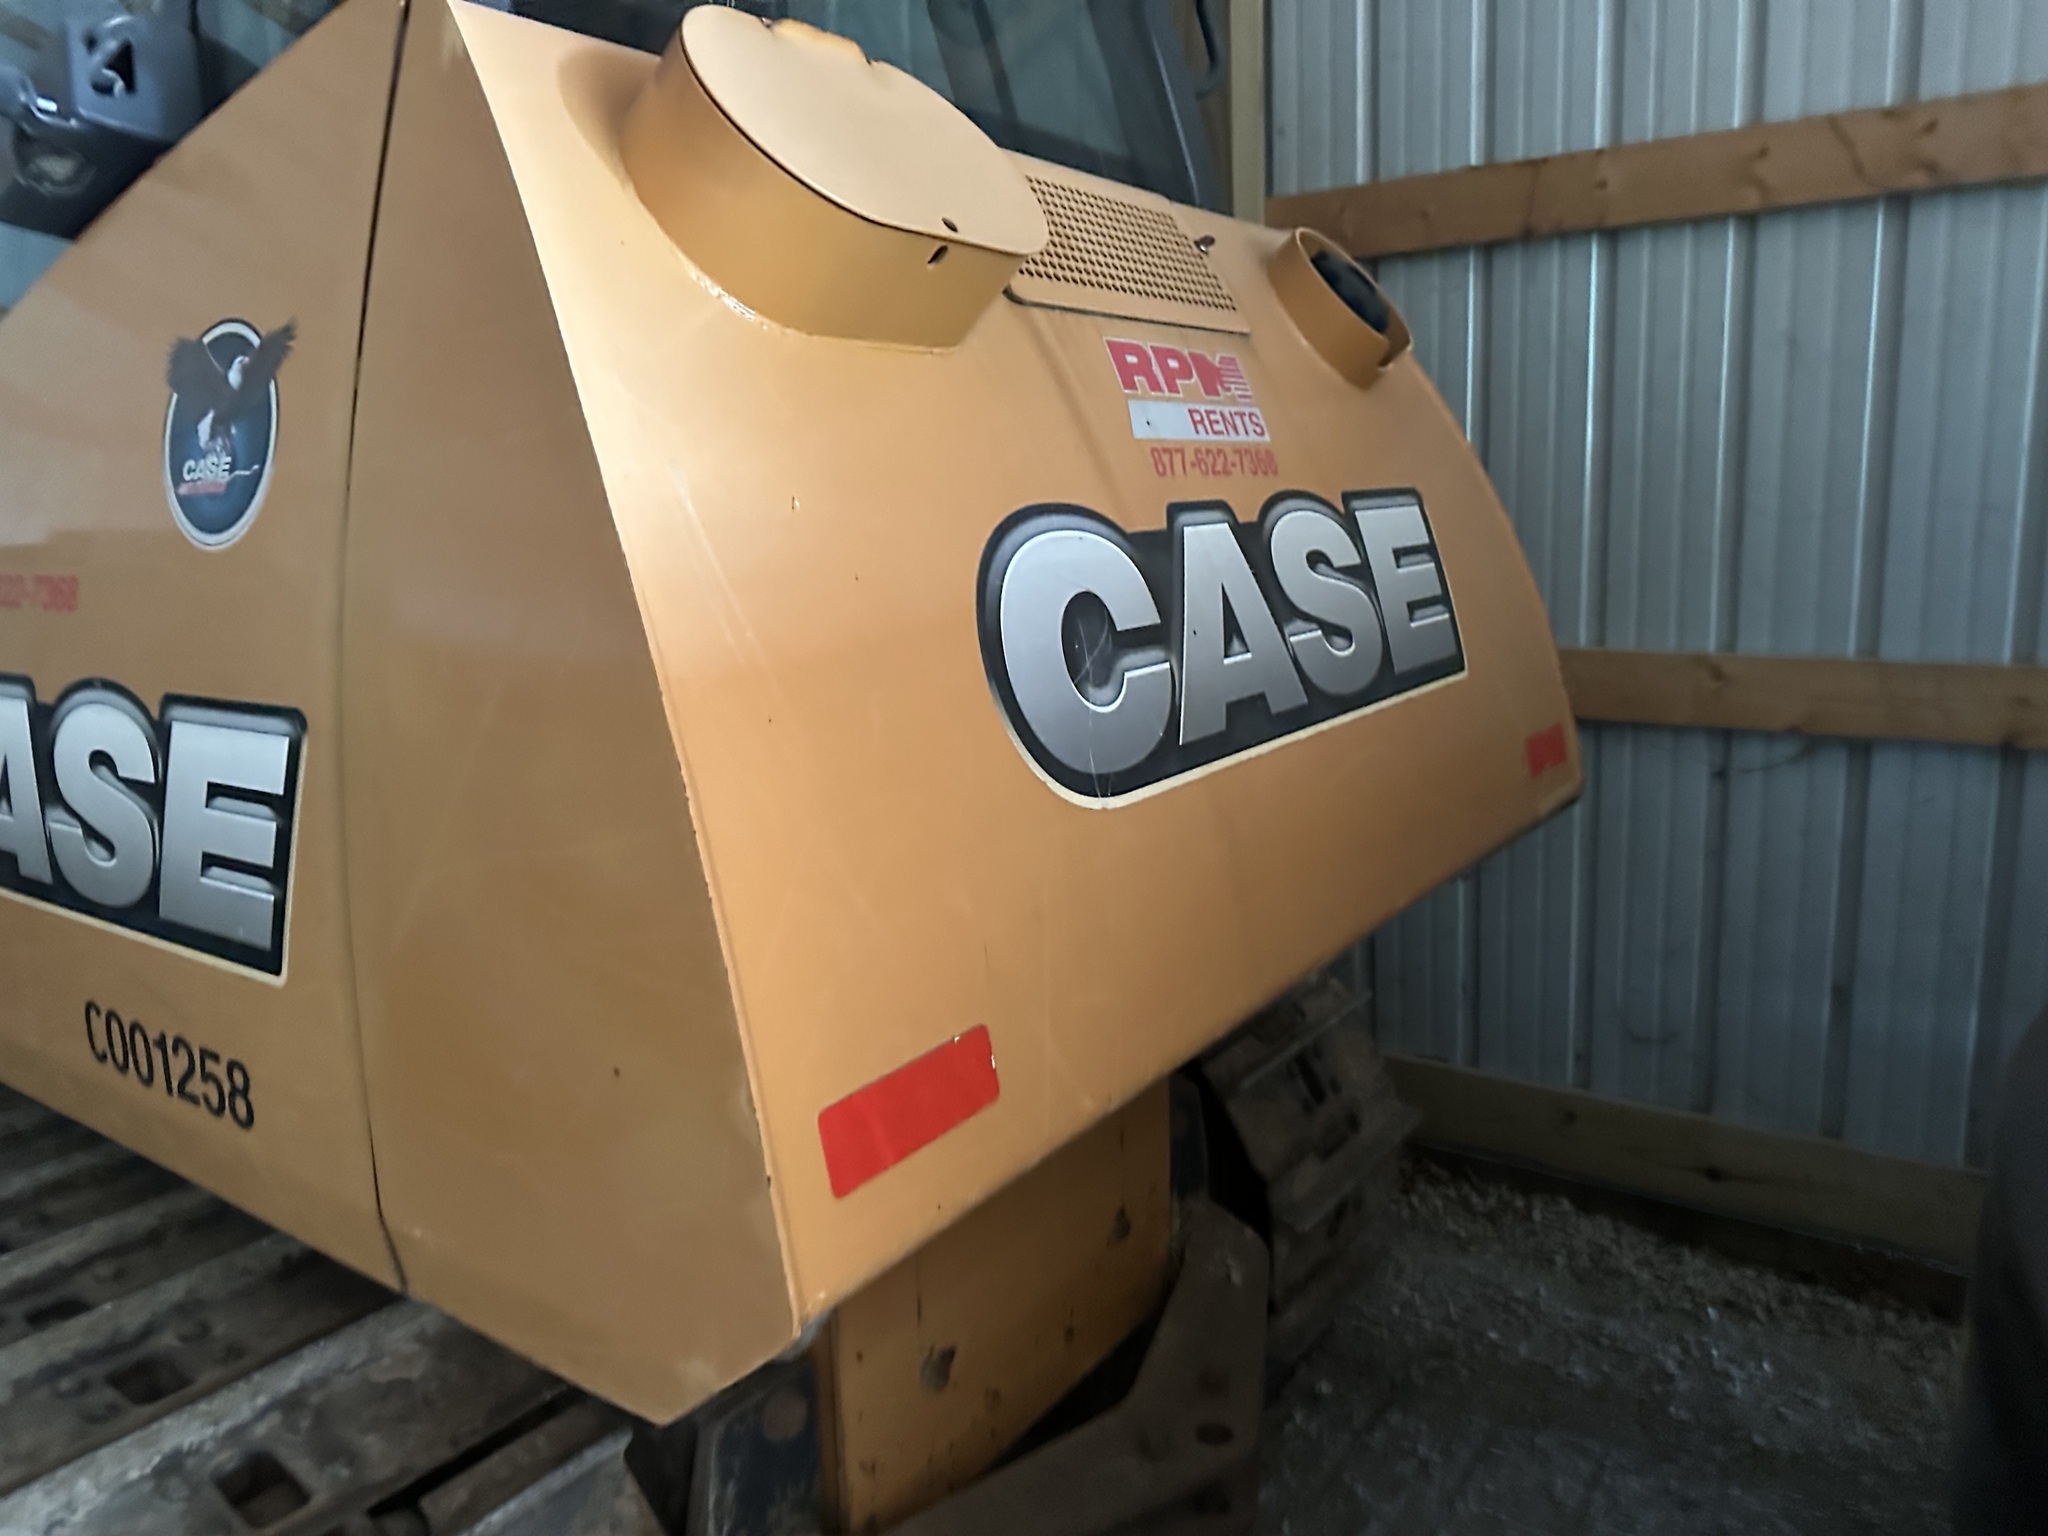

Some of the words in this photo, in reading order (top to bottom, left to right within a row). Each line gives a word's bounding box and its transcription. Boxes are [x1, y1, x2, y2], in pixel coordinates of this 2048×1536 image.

[1103, 336, 1255, 400] RPM
[1187, 408, 1266, 437] RENTS
[182, 455, 232, 481] CASE
[1150, 446, 1279, 477] 877-622-7368
[998, 502, 1459, 775] CASE
[84, 1000, 255, 1130] C001258
